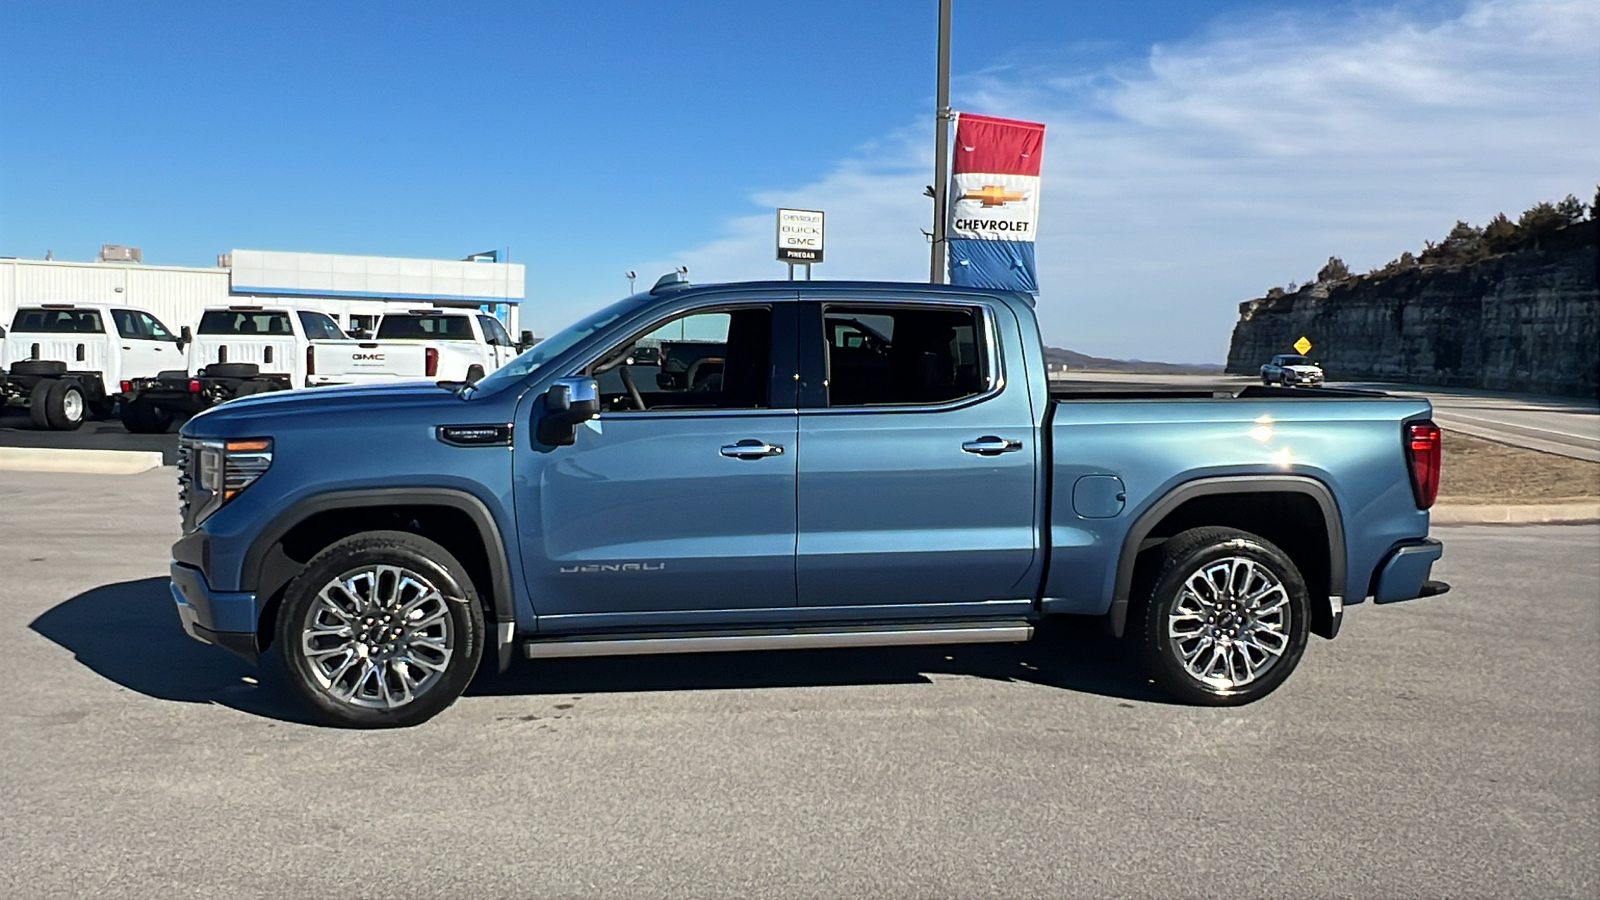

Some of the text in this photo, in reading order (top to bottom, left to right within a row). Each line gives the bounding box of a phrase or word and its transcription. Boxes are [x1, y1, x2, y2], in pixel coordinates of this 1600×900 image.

[783, 214, 820, 223] CHEVROLET
[955, 219, 1029, 232] CHEVROLET
[782, 226, 820, 235] BUICK
[787, 237, 816, 246] GMC
[352, 353, 385, 361] GMC
[560, 562, 665, 573] DENALI
